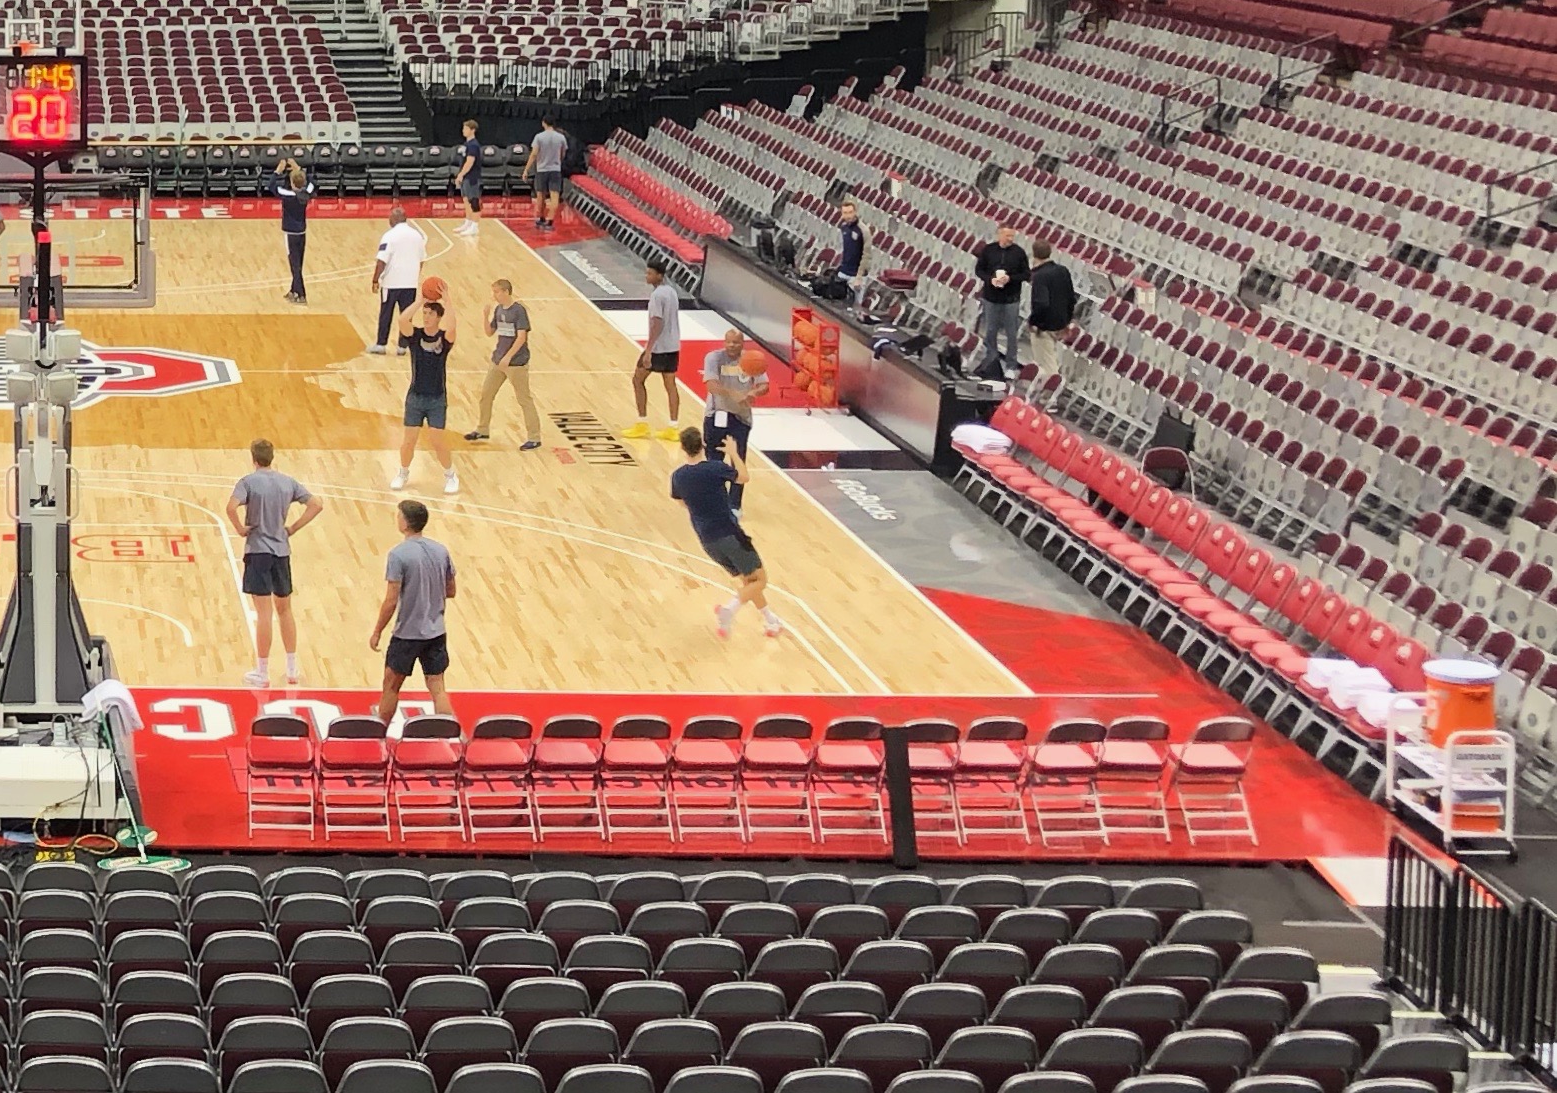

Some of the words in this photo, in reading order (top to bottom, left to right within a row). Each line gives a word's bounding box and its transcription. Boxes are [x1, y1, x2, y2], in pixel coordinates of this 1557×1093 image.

[11, 93, 68, 141] 20
[547, 411, 616, 441] VALUE
[573, 442, 640, 467] CITY
